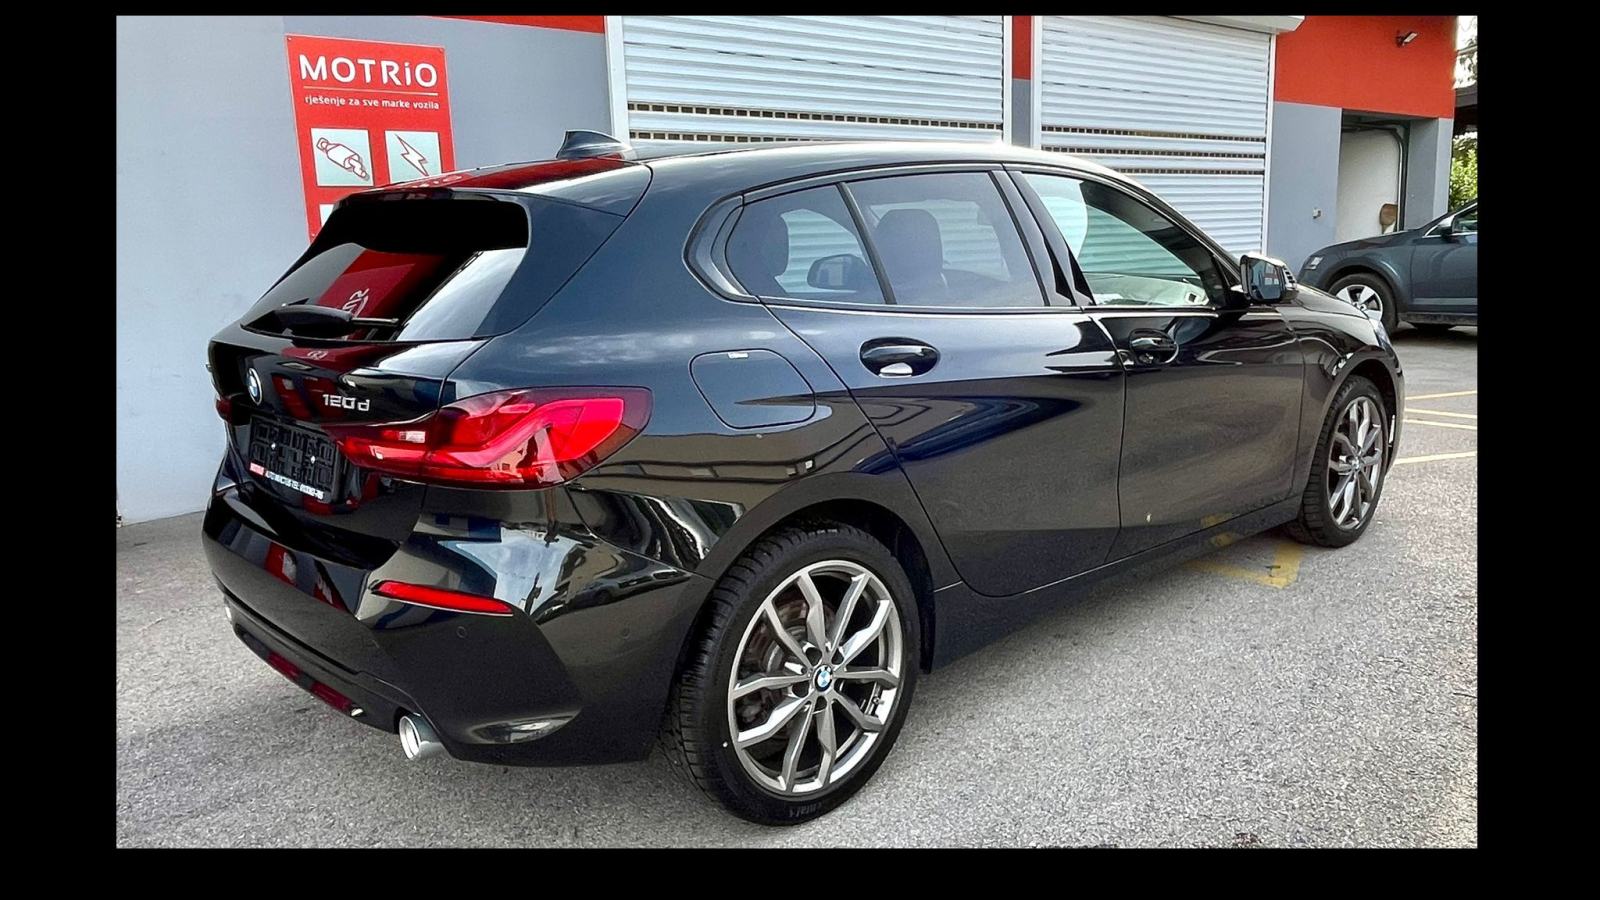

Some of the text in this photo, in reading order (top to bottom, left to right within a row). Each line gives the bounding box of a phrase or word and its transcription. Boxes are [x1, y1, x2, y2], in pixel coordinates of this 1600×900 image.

[305, 95, 440, 110] rješenje za sve marke vozila
